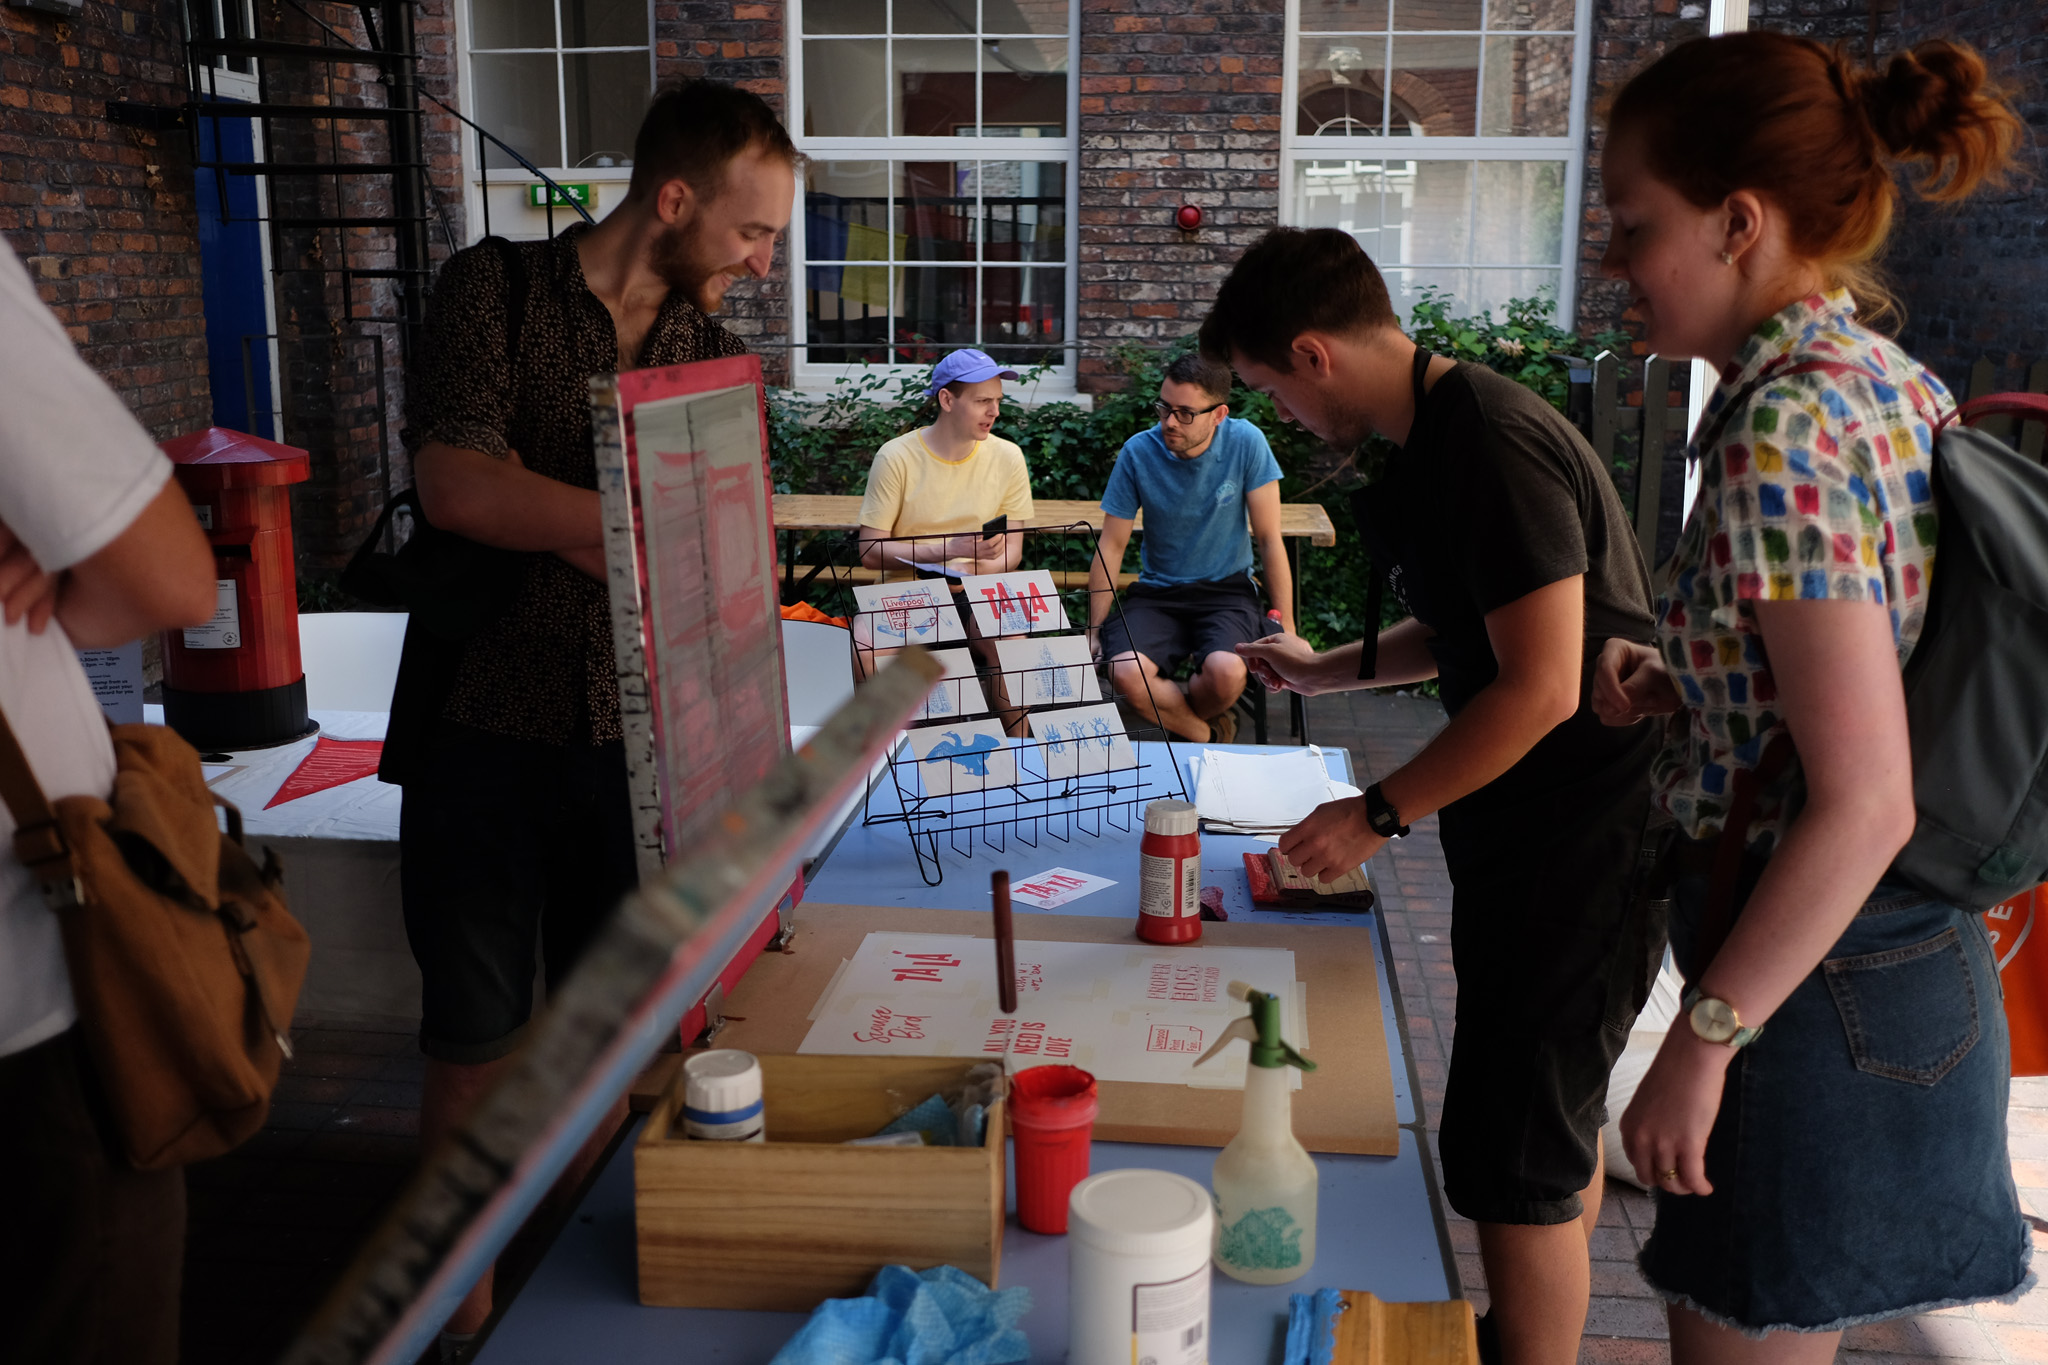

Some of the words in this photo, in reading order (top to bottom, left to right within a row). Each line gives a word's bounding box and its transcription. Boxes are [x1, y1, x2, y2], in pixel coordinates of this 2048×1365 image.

[886, 598, 925, 608] Liverpool
[1147, 964, 1172, 999] PROPER
[1168, 965, 1203, 1002] BOSS
[1201, 966, 1219, 1002] POSTCARD
[853, 1006, 892, 1044] Scouse
[888, 1014, 932, 1039] Bird
[988, 1019, 1017, 1035] YOU
[1020, 1022, 1046, 1031] IS
[982, 1038, 1011, 1052] ALL
[1012, 1033, 1043, 1055] NEED
[1043, 1036, 1073, 1058] LOVE
